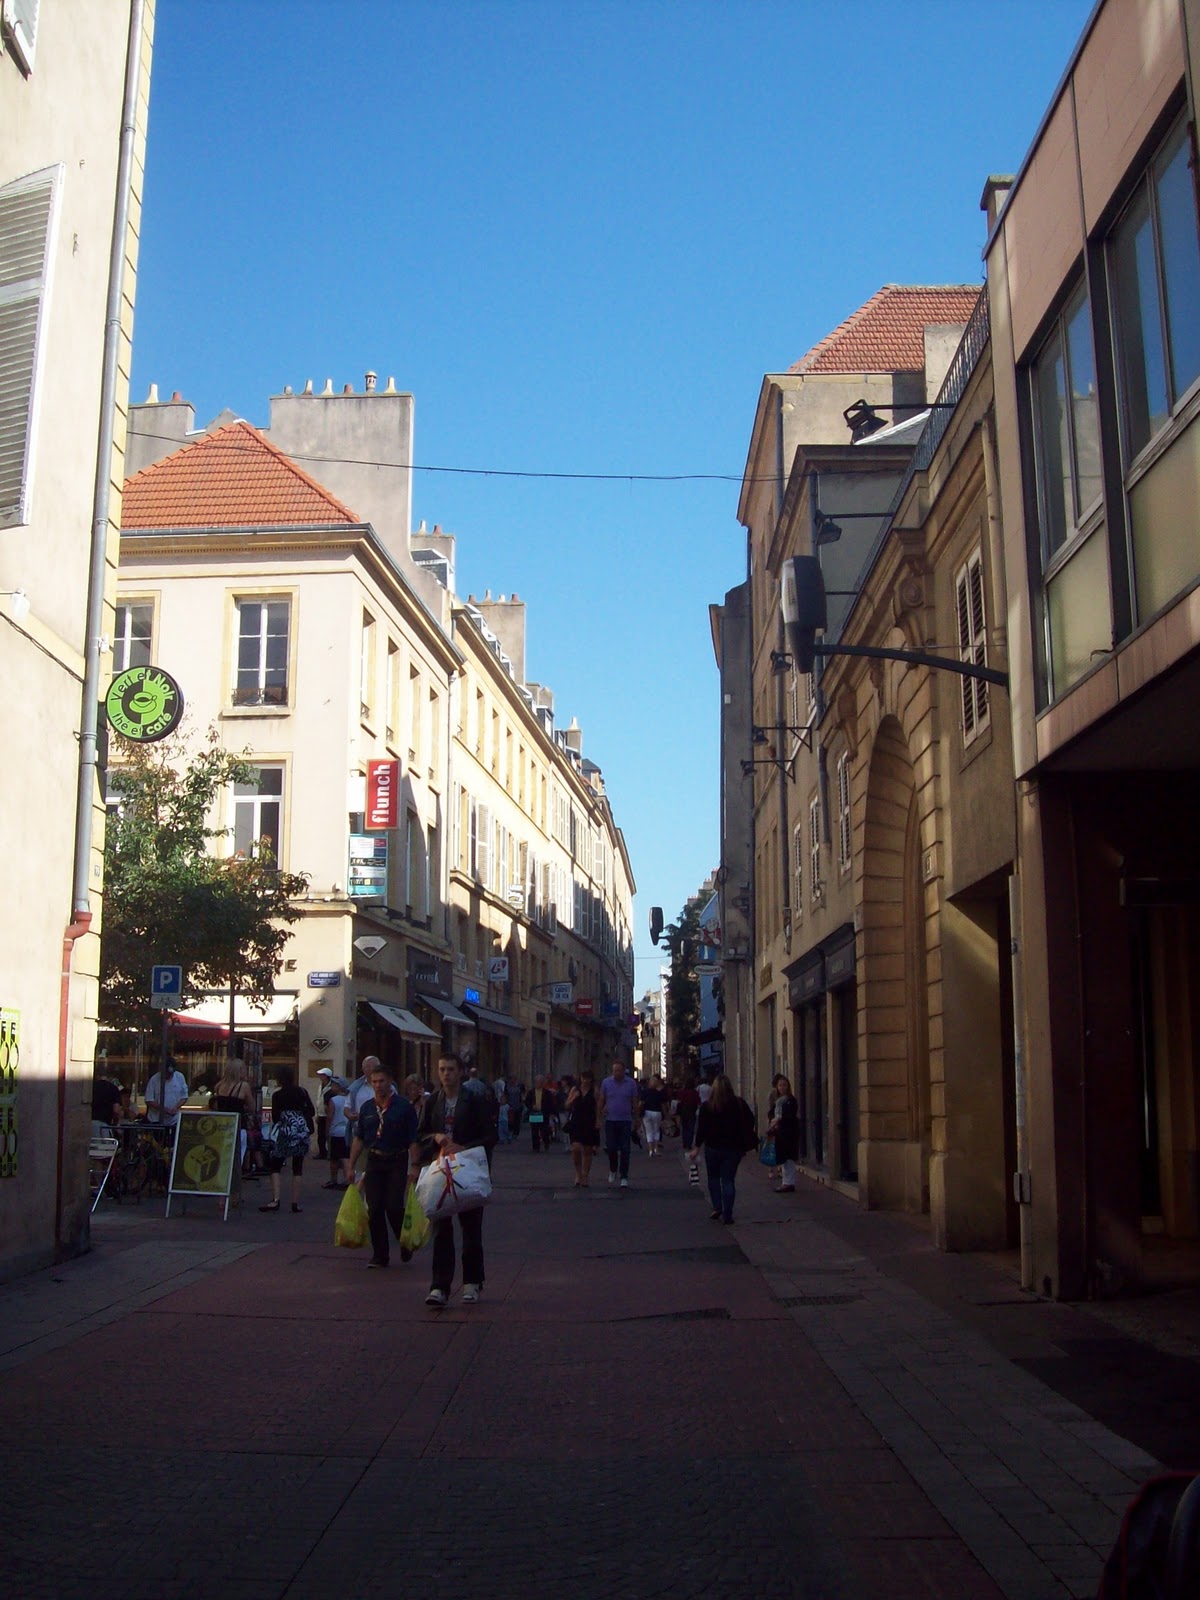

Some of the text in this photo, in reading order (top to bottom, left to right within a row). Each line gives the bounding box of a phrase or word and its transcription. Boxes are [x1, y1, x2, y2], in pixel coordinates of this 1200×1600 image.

[111, 669, 176, 701] Vert et Noir
[131, 725, 143, 735] et
[146, 711, 172, 735] café
[371, 763, 391, 824] flunch
[159, 971, 173, 989] P
